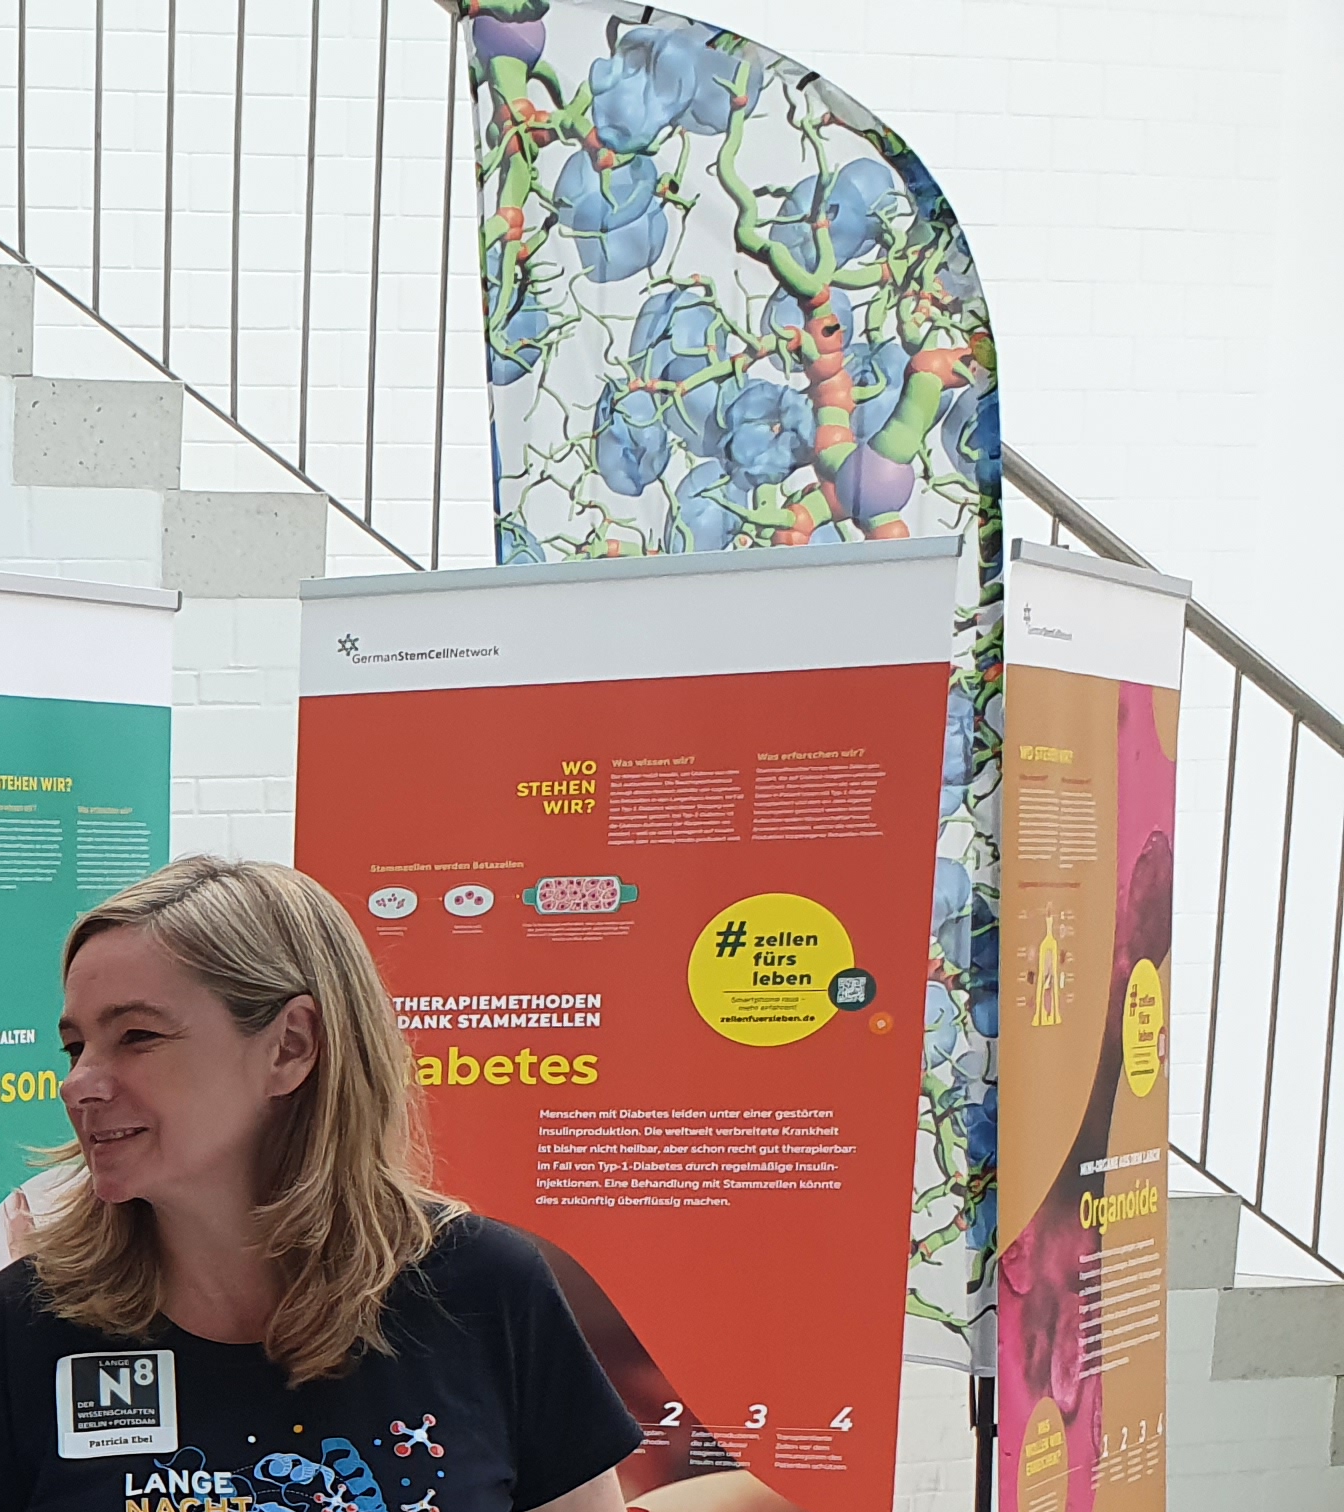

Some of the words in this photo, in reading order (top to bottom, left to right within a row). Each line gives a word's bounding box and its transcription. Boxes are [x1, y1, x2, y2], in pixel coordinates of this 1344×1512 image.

[352, 645, 500, 665] GermanStemCellNetwork
[562, 760, 597, 776] WO
[41, 777, 73, 793] WIR?
[516, 779, 597, 797] STEHEN
[542, 799, 596, 815] WIR?
[716, 921, 747, 957] #
[753, 932, 818, 947] zellen
[753, 951, 797, 967] fürs
[752, 971, 812, 986] leben
[393, 994, 602, 1011] THERAPIEMETHODEN
[397, 1014, 453, 1030] DANK
[457, 1013, 601, 1029] STAMMZELLEN
[416, 1046, 599, 1086] abetes
[539, 1108, 596, 1119] Menschen
[598, 1108, 617, 1119] mit
[619, 1108, 669, 1119] Diabetes
[671, 1108, 707, 1119] leiden
[709, 1109, 741, 1119] unter
[743, 1108, 774, 1119] einer
[775, 1108, 834, 1121] gestörten
[604, 1178, 628, 1189] Eine
[630, 1177, 700, 1191] Behandlung
[702, 1178, 721, 1189] mit
[723, 1177, 797, 1190] Stammzellen
[799, 1177, 842, 1189] könnte
[1079, 1178, 1158, 1235] Organoide
[77, 1401, 95, 1409] DER
[78, 1408, 155, 1419] WISSENSCHAFTEN
[659, 1401, 684, 1427] 2
[745, 1404, 768, 1429] 3
[829, 1406, 853, 1432] 4
[78, 1421, 108, 1430] BERLIN
[113, 1418, 156, 1426] POTSDAM
[89, 1437, 129, 1448] Patricia
[131, 1435, 153, 1444] Ebel
[125, 1470, 234, 1497] LANGE
